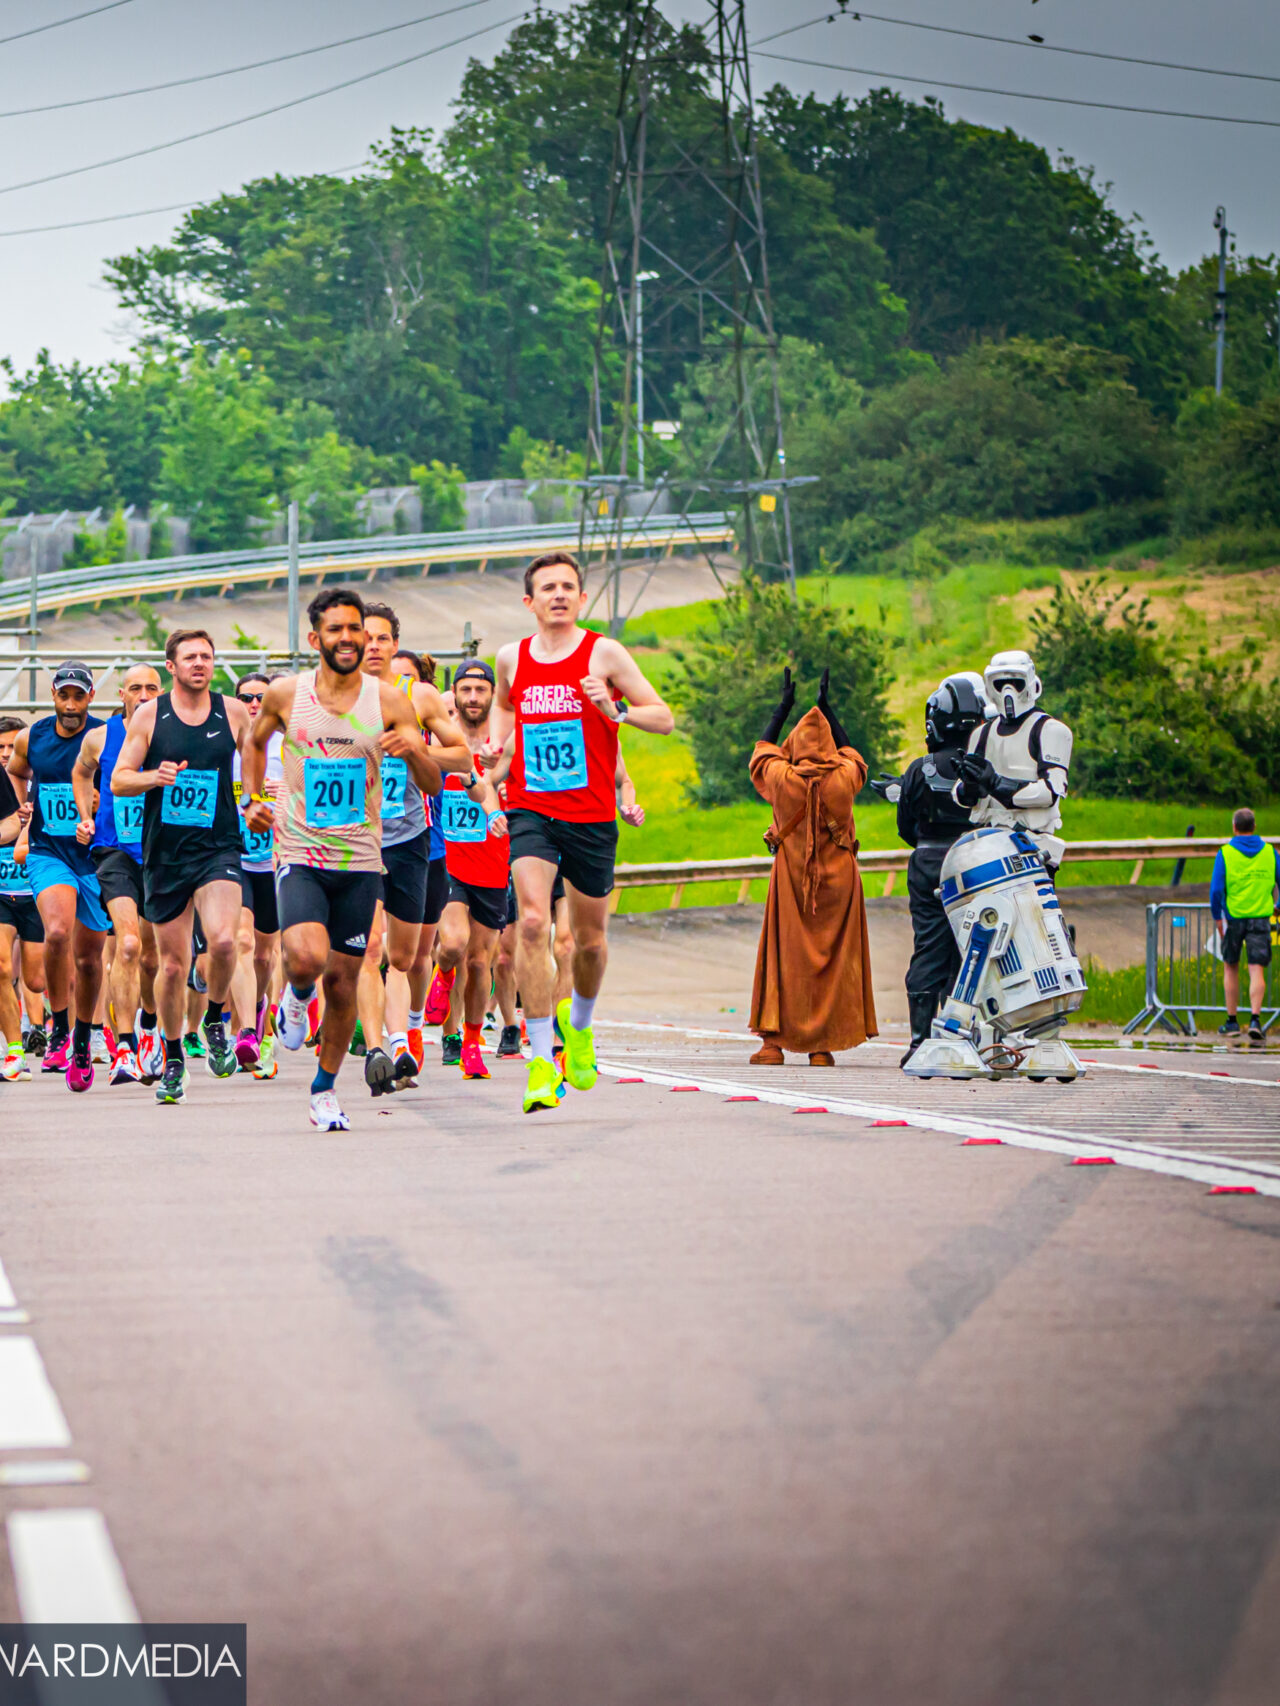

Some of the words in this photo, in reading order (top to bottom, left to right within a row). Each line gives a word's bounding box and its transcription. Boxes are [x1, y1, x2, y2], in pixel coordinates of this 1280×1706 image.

[531, 685, 565, 701] RED
[520, 700, 583, 714] RUNNERS
[534, 743, 576, 772] 103
[171, 786, 209, 810] 092
[313, 779, 355, 807] 201
[47, 799, 78, 820] 105
[124, 805, 144, 828] 12
[448, 806, 480, 828] 129
